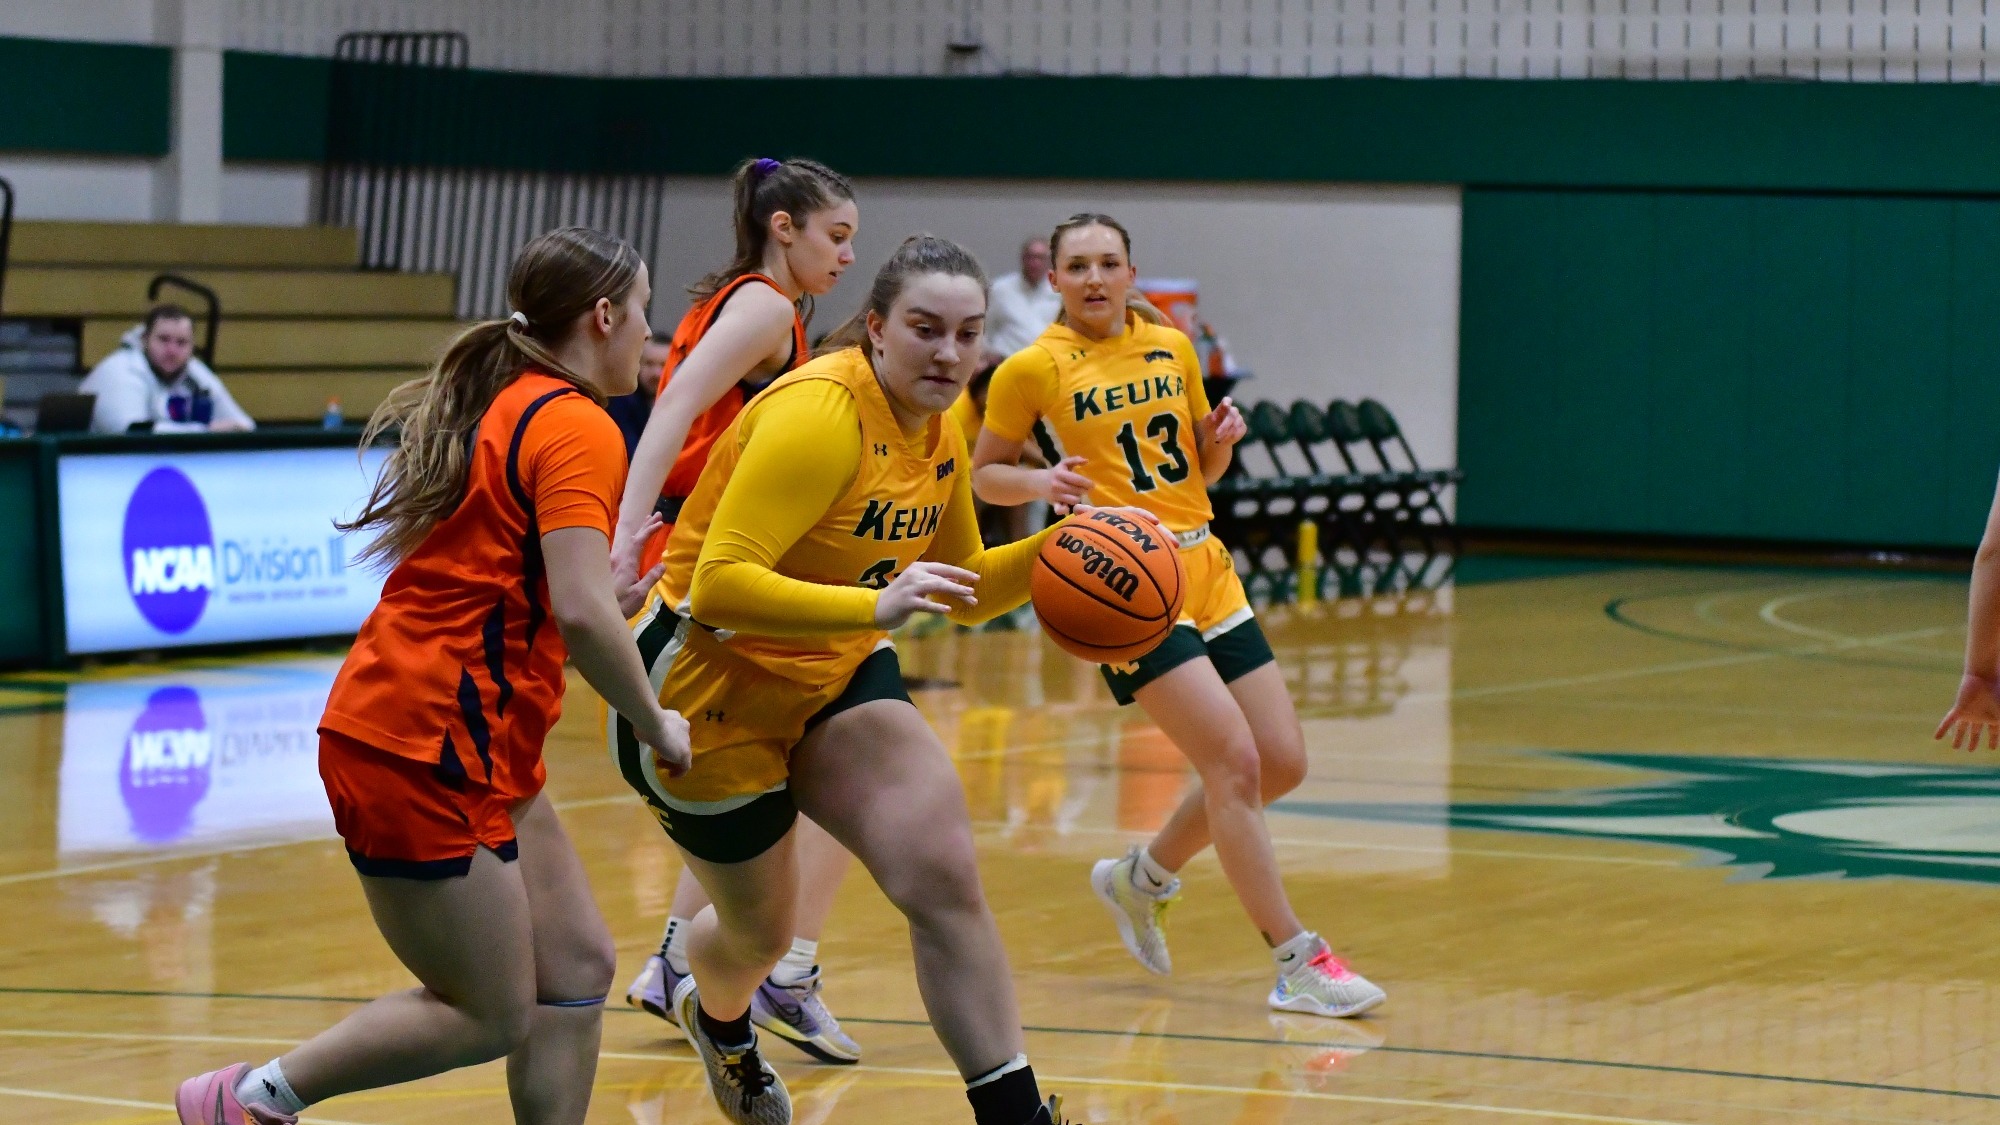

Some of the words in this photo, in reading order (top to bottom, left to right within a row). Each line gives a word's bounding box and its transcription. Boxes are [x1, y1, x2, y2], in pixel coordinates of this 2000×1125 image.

[1073, 375, 1186, 421] KEUKA
[1115, 412, 1190, 493] 13
[1091, 511, 1160, 553] NCAA
[133, 545, 214, 595] NCAA
[222, 540, 322, 584] Division
[1055, 533, 1139, 602] Wilson
